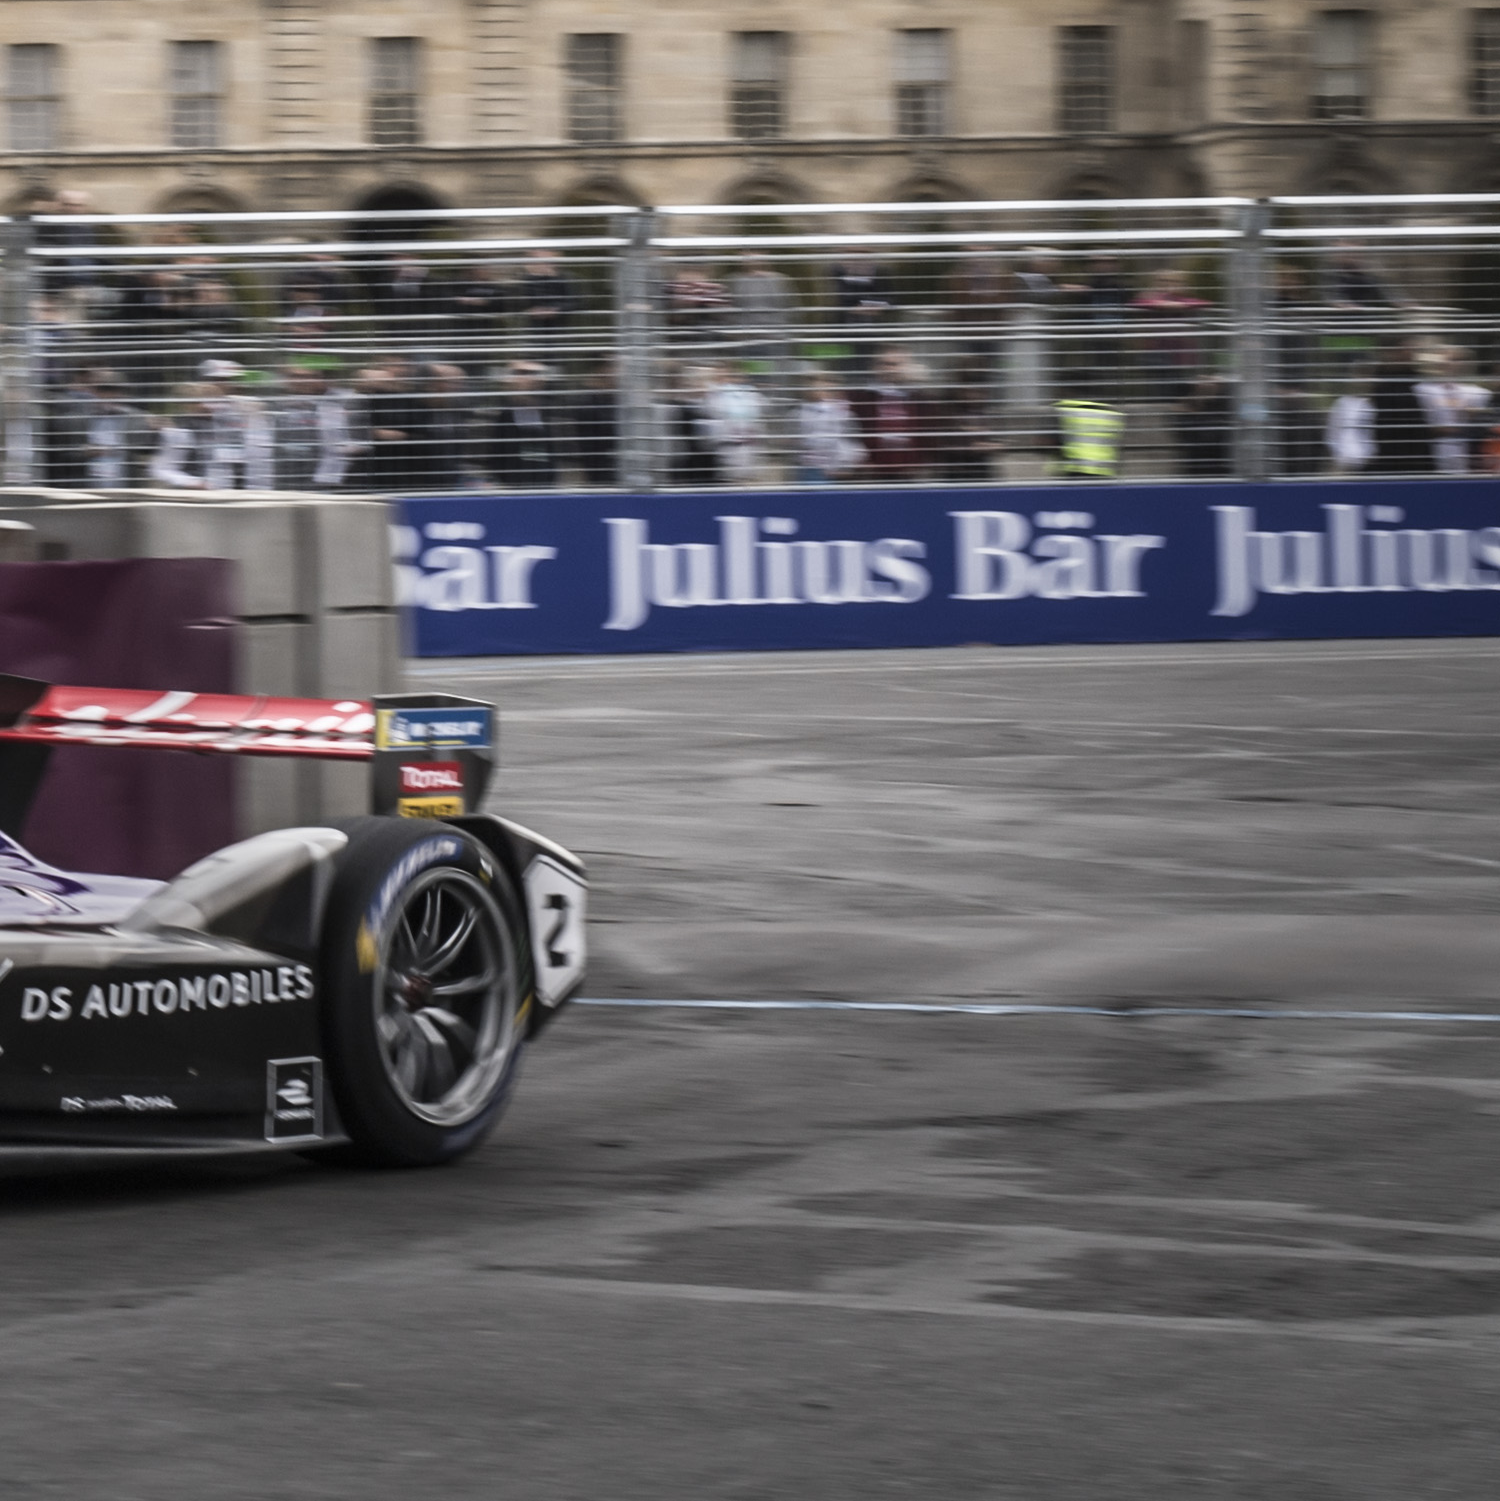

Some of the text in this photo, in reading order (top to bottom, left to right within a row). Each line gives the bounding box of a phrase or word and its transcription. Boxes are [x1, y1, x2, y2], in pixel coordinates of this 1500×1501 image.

[600, 516, 932, 631] Julius
[946, 510, 1166, 600] Bär
[542, 893, 577, 968] 2
[20, 965, 315, 1022] DS AUTOMOBILES
